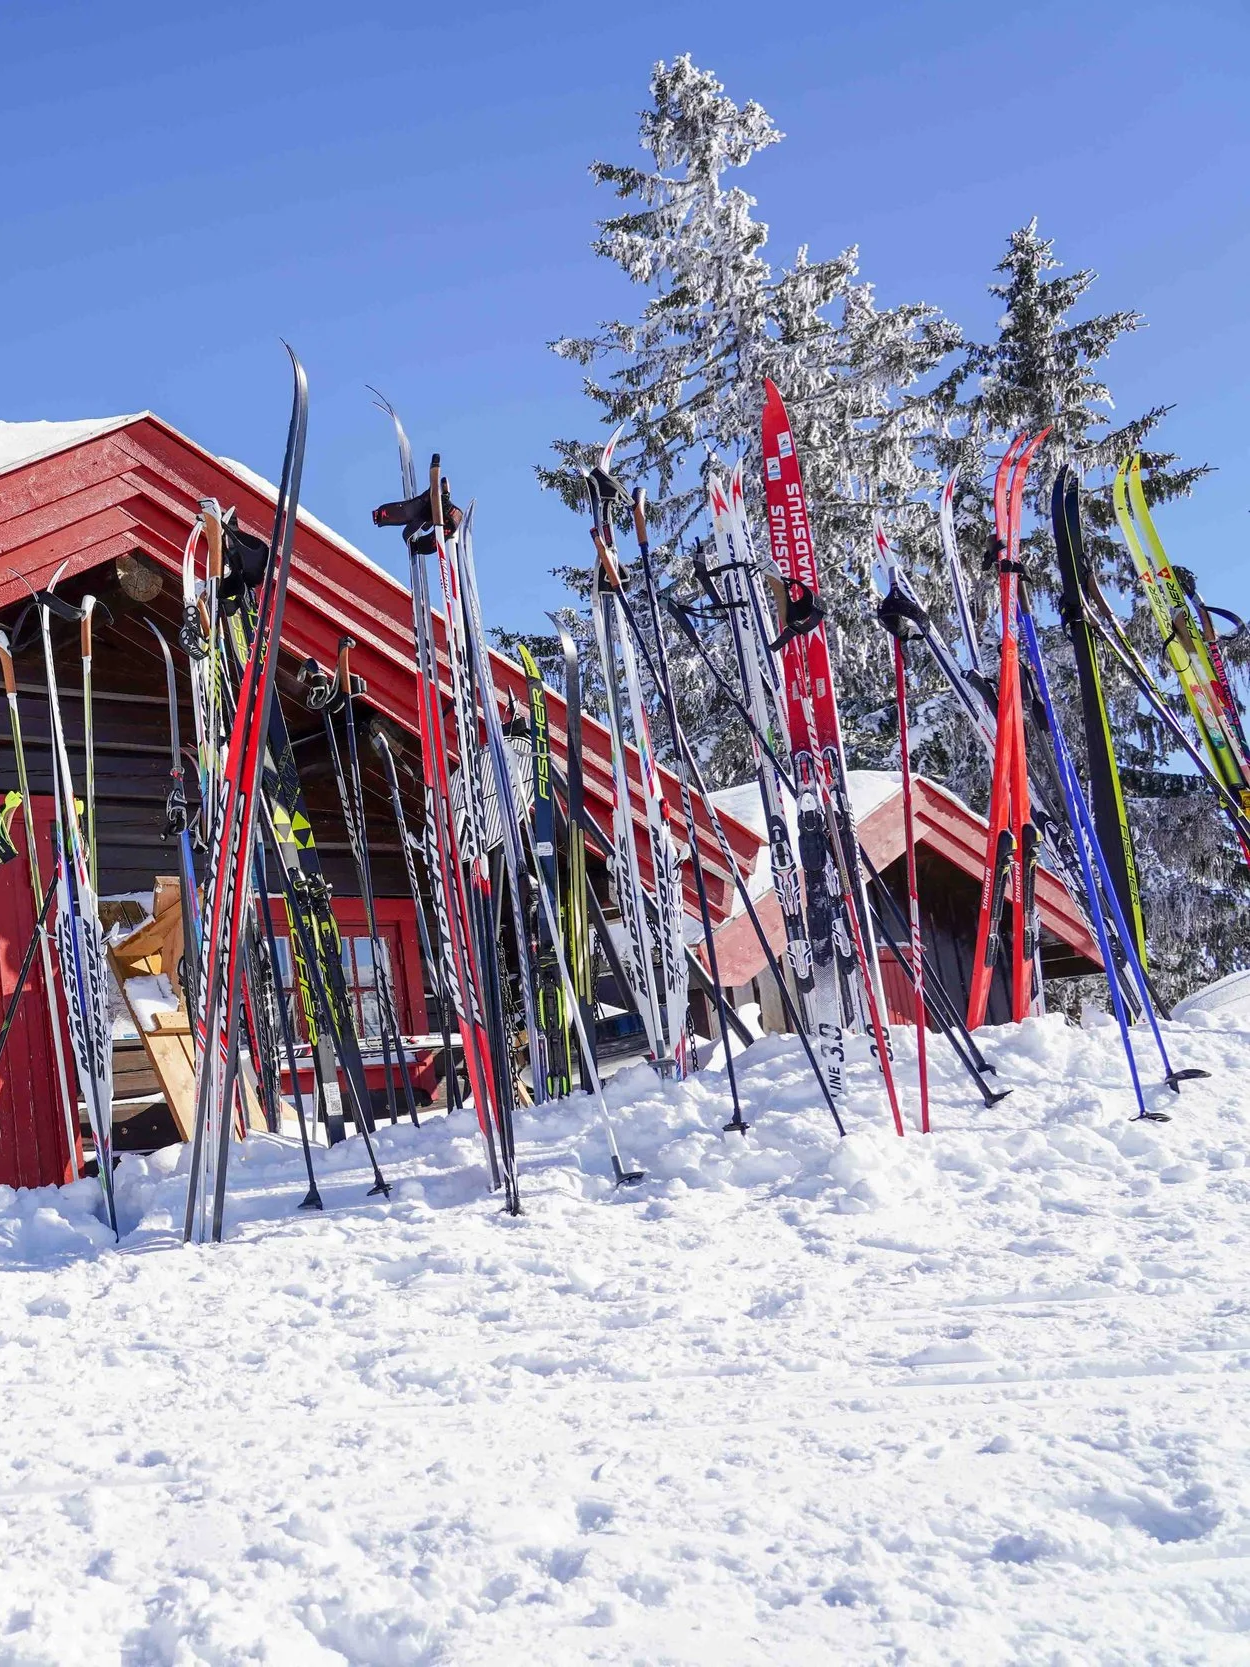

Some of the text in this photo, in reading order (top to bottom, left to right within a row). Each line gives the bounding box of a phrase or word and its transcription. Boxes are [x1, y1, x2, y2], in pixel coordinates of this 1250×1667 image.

[440, 557, 451, 603] MADSHUS
[771, 505, 791, 578] DSHUS
[785, 483, 814, 587] MADSHUS
[1166, 582, 1197, 640] FIHER
[531, 687, 549, 800] FISCHER
[618, 834, 648, 999] MADSHUS
[650, 823, 676, 994] MADSHUS
[982, 866, 991, 911] MADSHUS
[1121, 824, 1138, 906] FISCHER
[62, 911, 90, 1074] MADSHUS
[83, 918, 106, 1081] MADSHUS
[285, 892, 317, 1046] SCHER
[819, 1023, 844, 1062] 3.0
